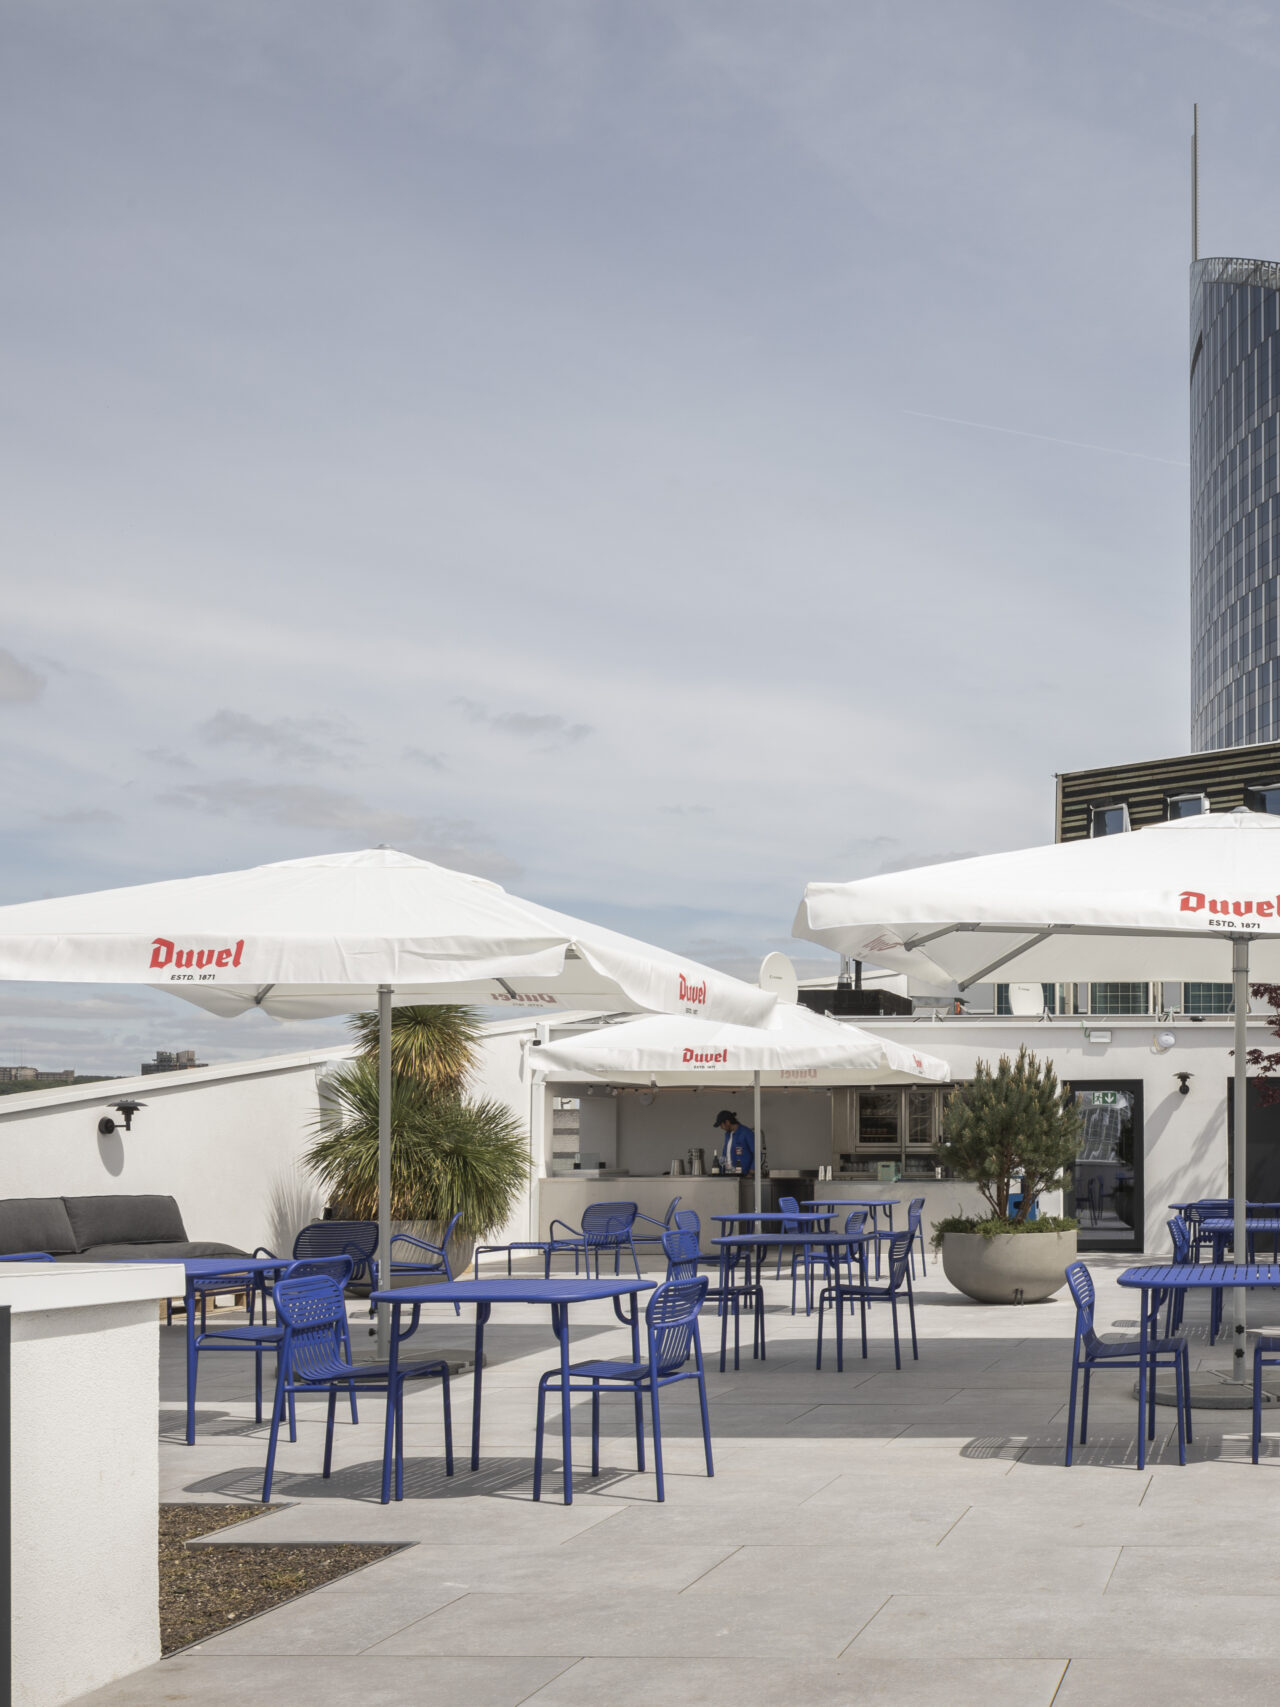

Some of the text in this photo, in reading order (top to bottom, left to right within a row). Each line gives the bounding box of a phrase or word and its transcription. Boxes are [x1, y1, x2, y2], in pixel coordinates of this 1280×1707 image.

[1208, 919, 1237, 928] ESTD.
[149, 937, 245, 969] Duvel
[679, 972, 707, 1005] Duvel
[682, 1048, 728, 1063] Duvel
